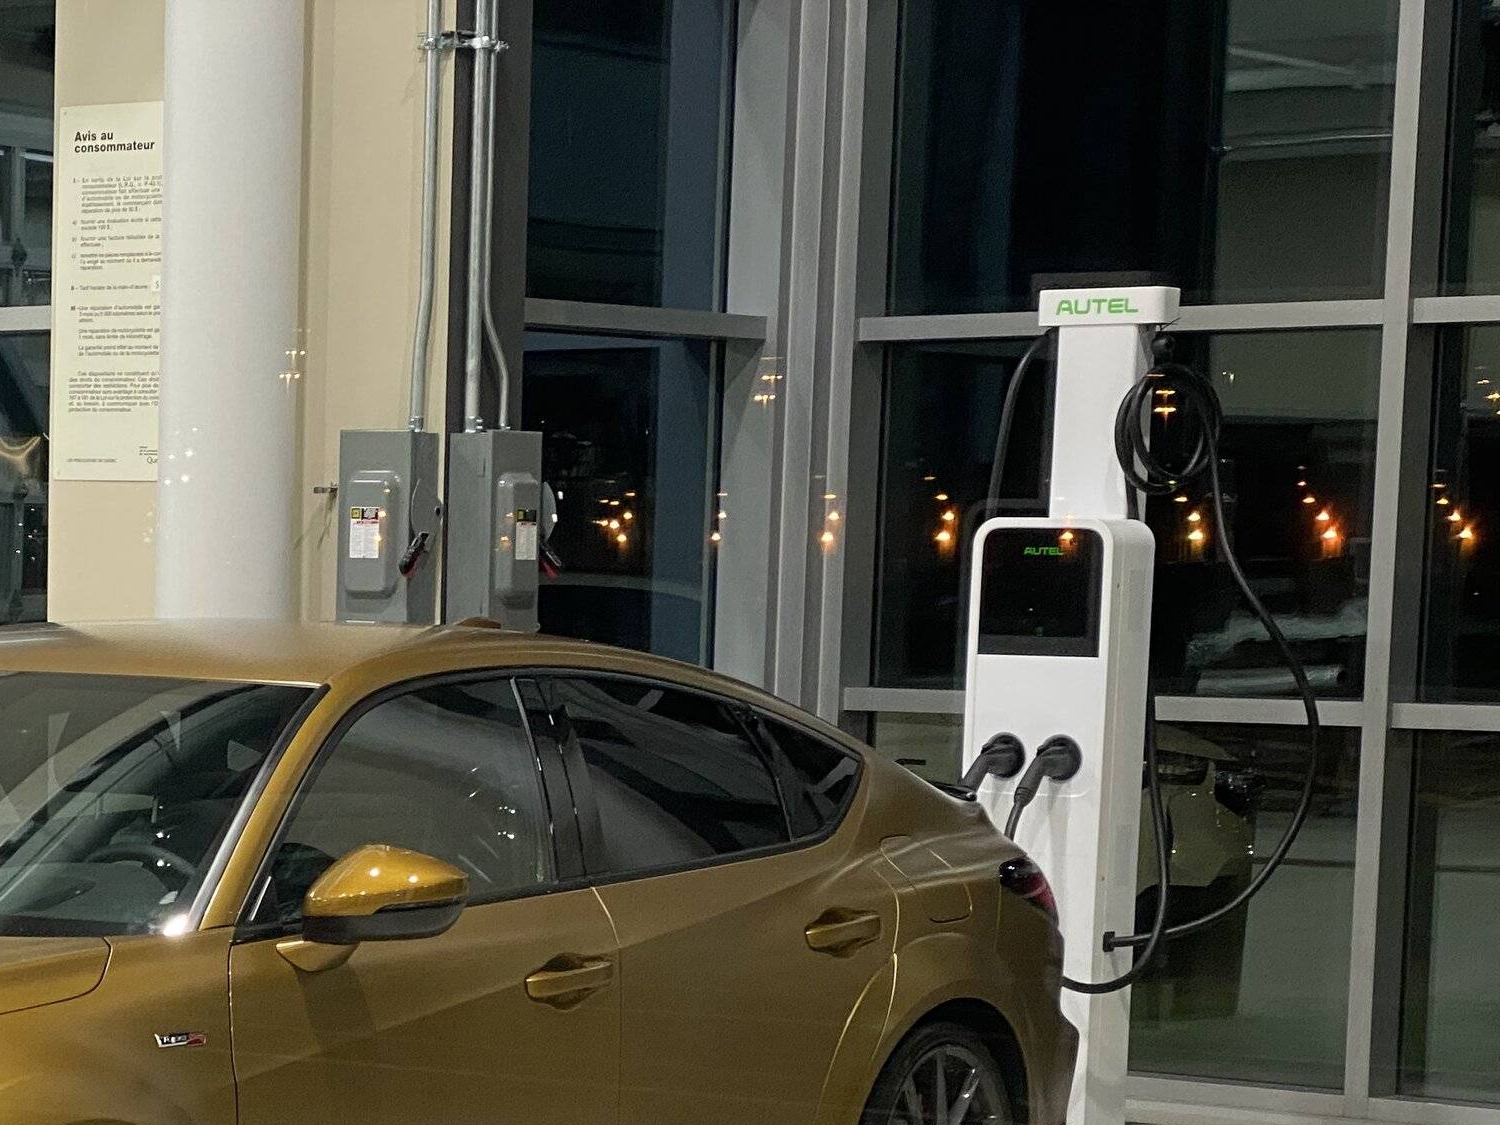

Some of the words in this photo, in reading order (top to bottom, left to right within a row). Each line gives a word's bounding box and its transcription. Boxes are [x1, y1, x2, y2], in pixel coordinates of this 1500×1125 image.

[74, 131, 97, 142] Avis
[100, 131, 114, 141] au
[74, 141, 156, 153] consommateur
[1055, 298, 1139, 316] AUTEL
[1023, 546, 1065, 556] AUTEL
